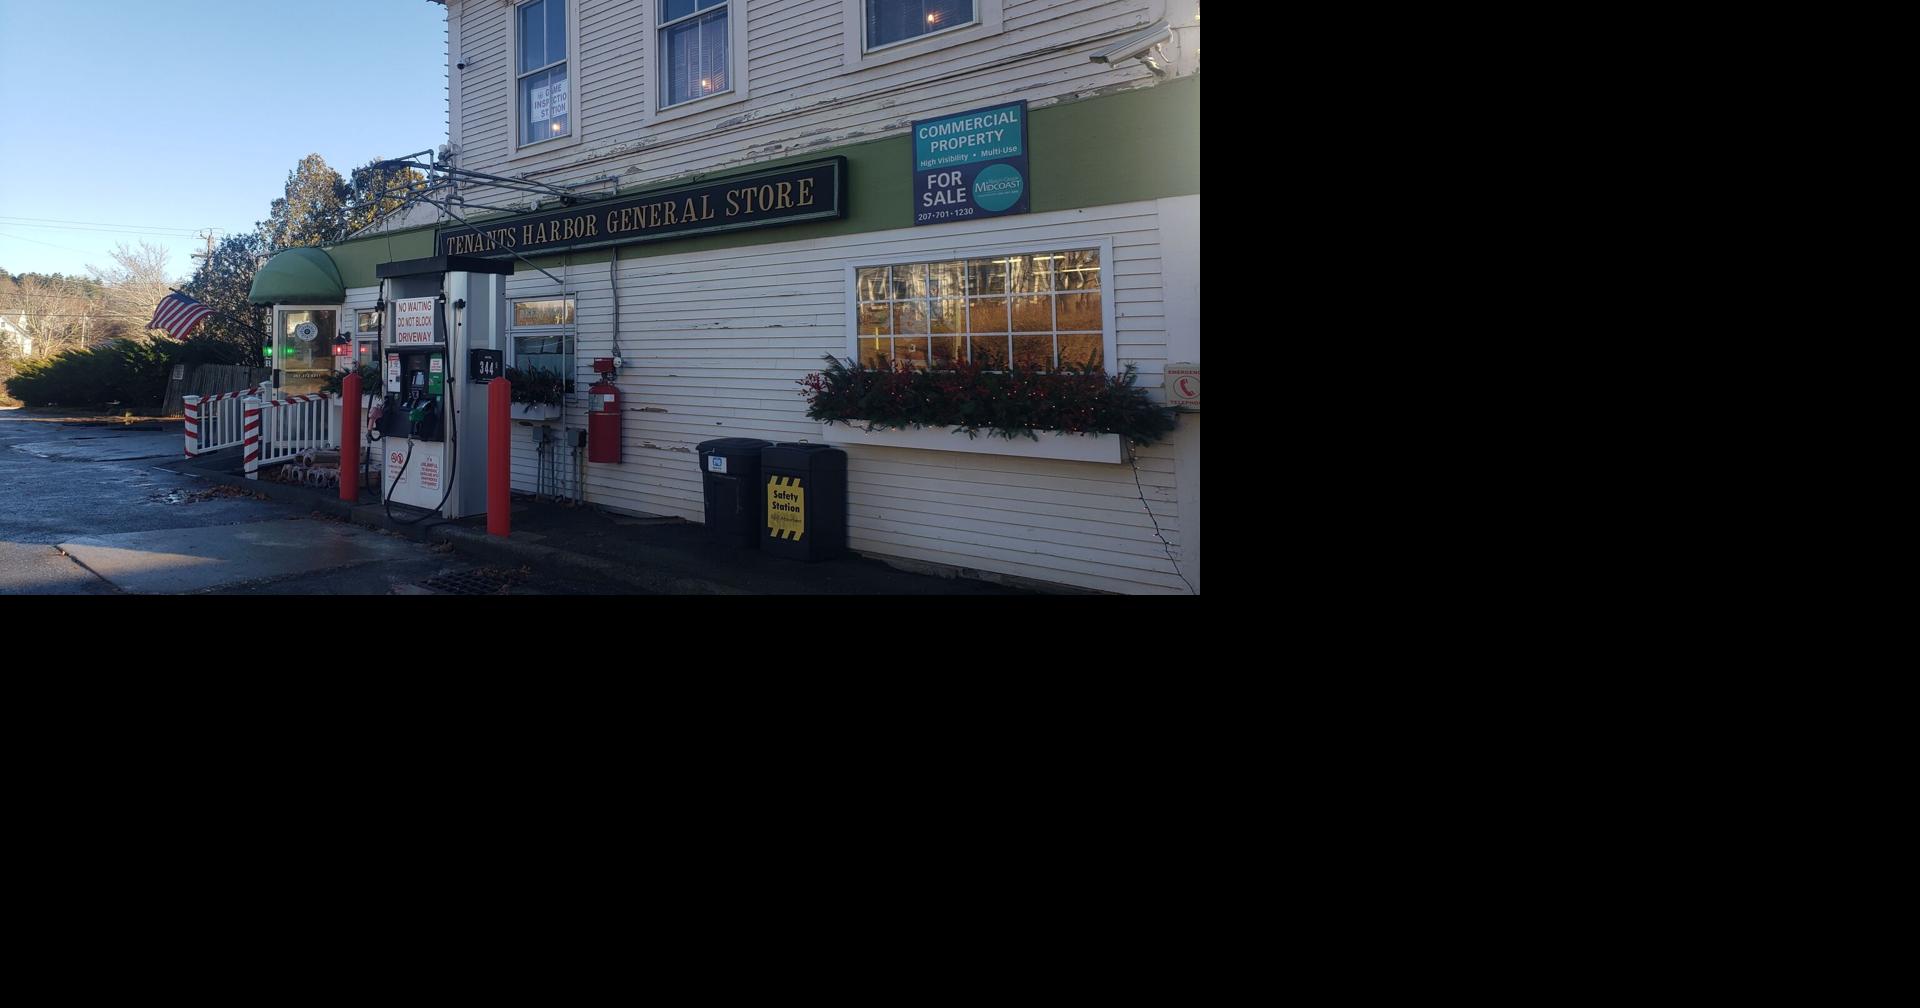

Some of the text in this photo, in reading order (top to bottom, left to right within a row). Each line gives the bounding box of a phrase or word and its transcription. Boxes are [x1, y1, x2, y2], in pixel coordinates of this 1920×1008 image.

[541, 102, 566, 118] STTION
[919, 110, 1018, 139] COMMERCIAL
[930, 129, 1004, 153] PROPERTY
[920, 145, 1018, 168] High Visibility Multi-Use
[927, 171, 963, 190] FOR
[923, 188, 967, 207] SALE
[447, 177, 815, 256] TENANTS HARBOR GENERAL STORE
[398, 300, 432, 313] NO WAITING
[398, 315, 432, 328] DO NOT BLOCK
[398, 331, 432, 343] DRIVEWAY
[773, 490, 798, 502] Safety
[772, 501, 800, 513] Station
